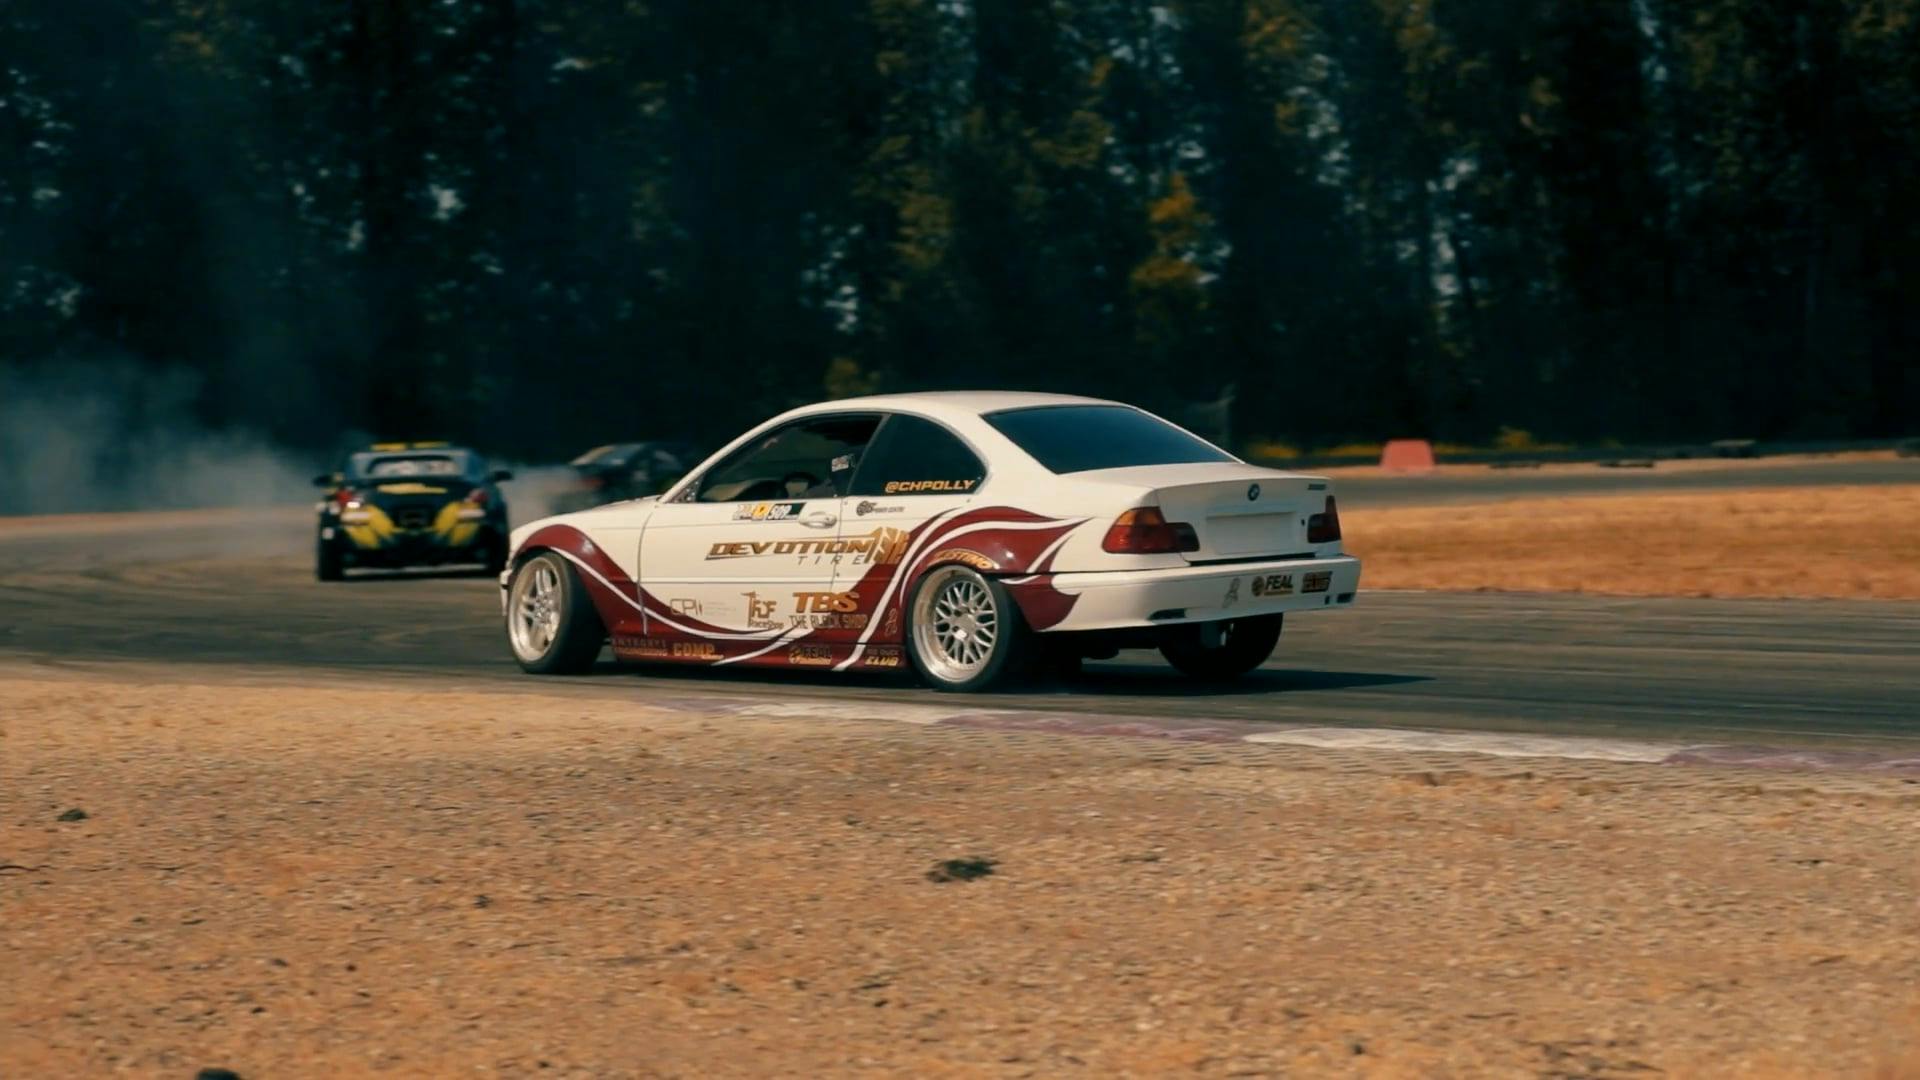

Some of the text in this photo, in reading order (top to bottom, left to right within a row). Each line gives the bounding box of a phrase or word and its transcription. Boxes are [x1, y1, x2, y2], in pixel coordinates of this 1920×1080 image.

[885, 480, 975, 493] @CHPOLLY
[708, 539, 873, 557] DEVOTION
[798, 554, 865, 565] TIRE
[1265, 574, 1294, 590] FEAL
[792, 591, 860, 613] TBS
